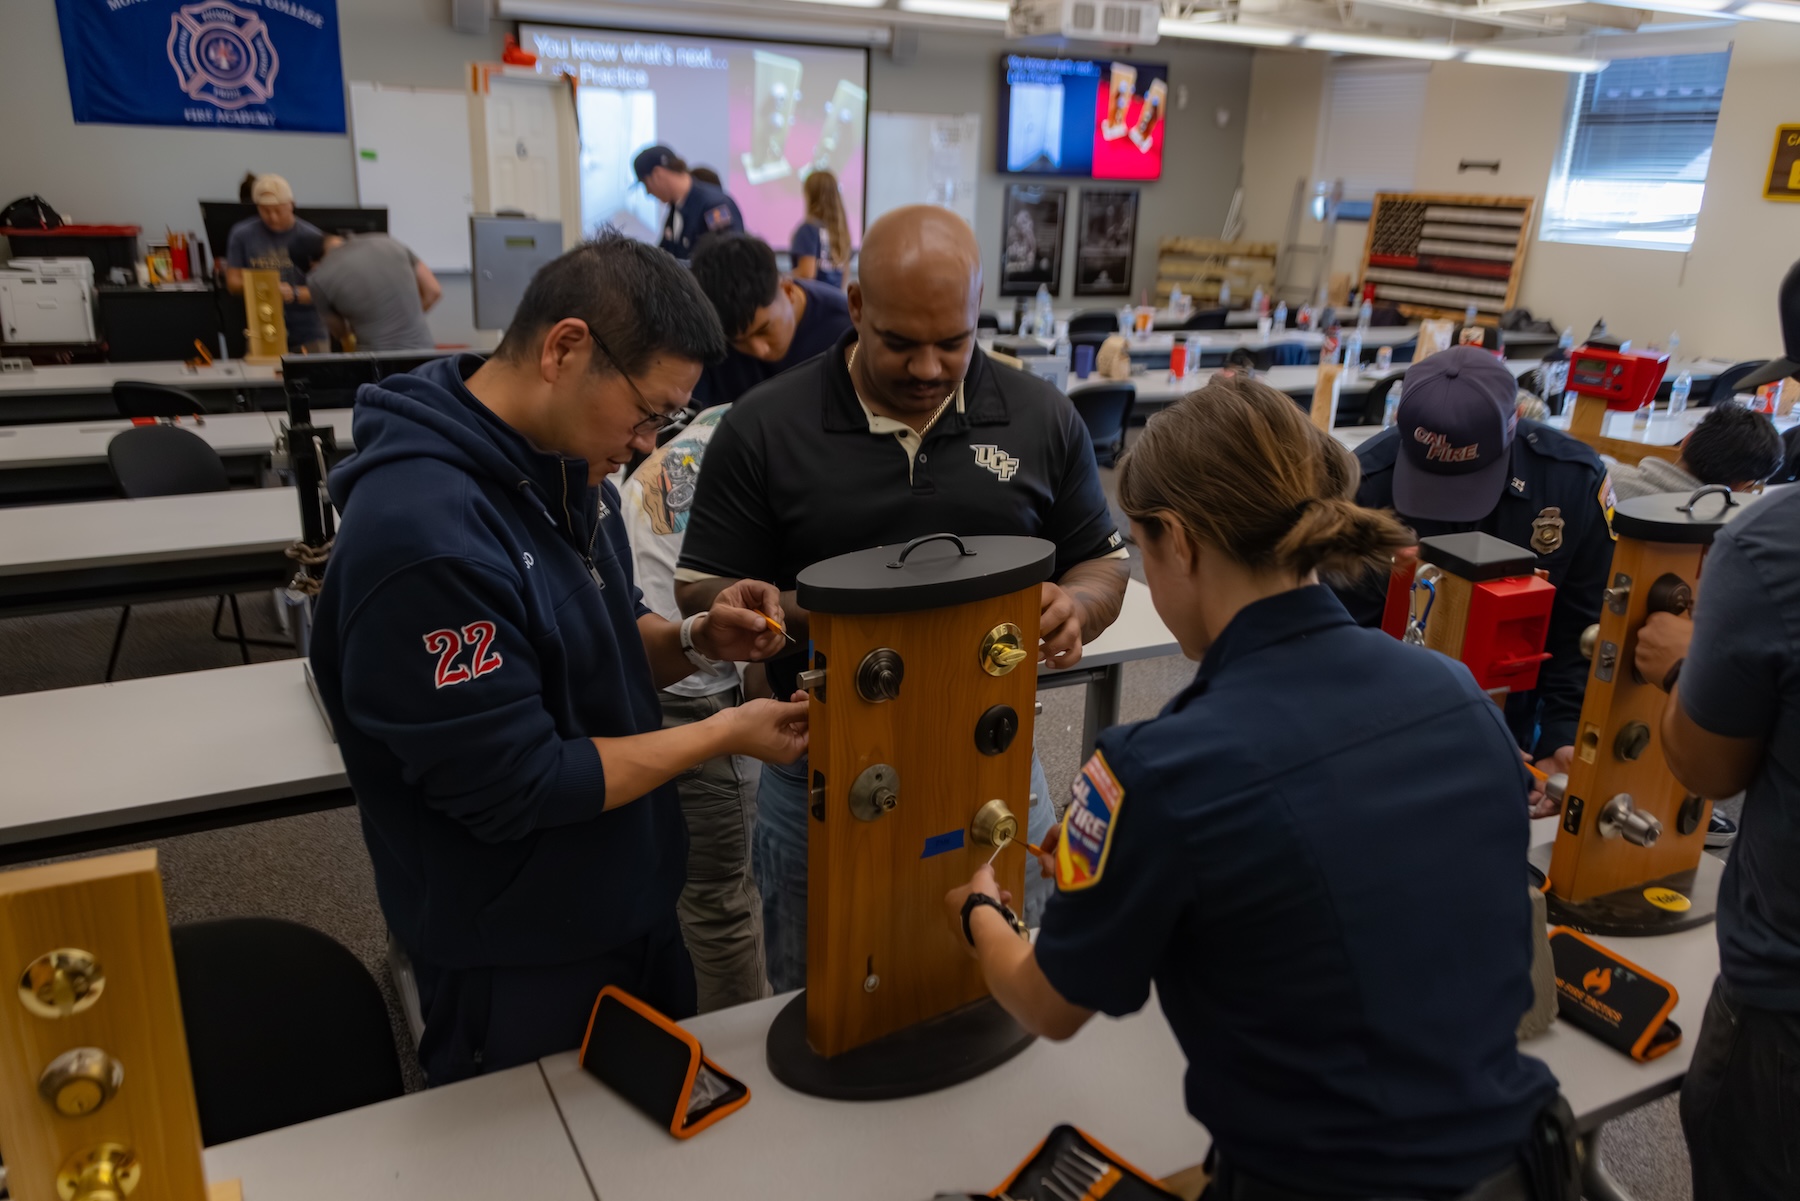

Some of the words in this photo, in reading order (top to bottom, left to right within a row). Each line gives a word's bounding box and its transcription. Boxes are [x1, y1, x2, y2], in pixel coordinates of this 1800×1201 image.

[533, 33, 569, 59] You
[571, 35, 619, 62] know
[620, 41, 674, 67] what's
[579, 62, 649, 88] Practice
[184, 108, 214, 123] FIRE
[216, 109, 277, 126] ACADEMY
[1414, 426, 1451, 449] CAL
[1426, 442, 1479, 462] FIRE
[970, 445, 1020, 481] UCF
[422, 620, 503, 689] 22
[1070, 799, 1108, 840] FIRE
